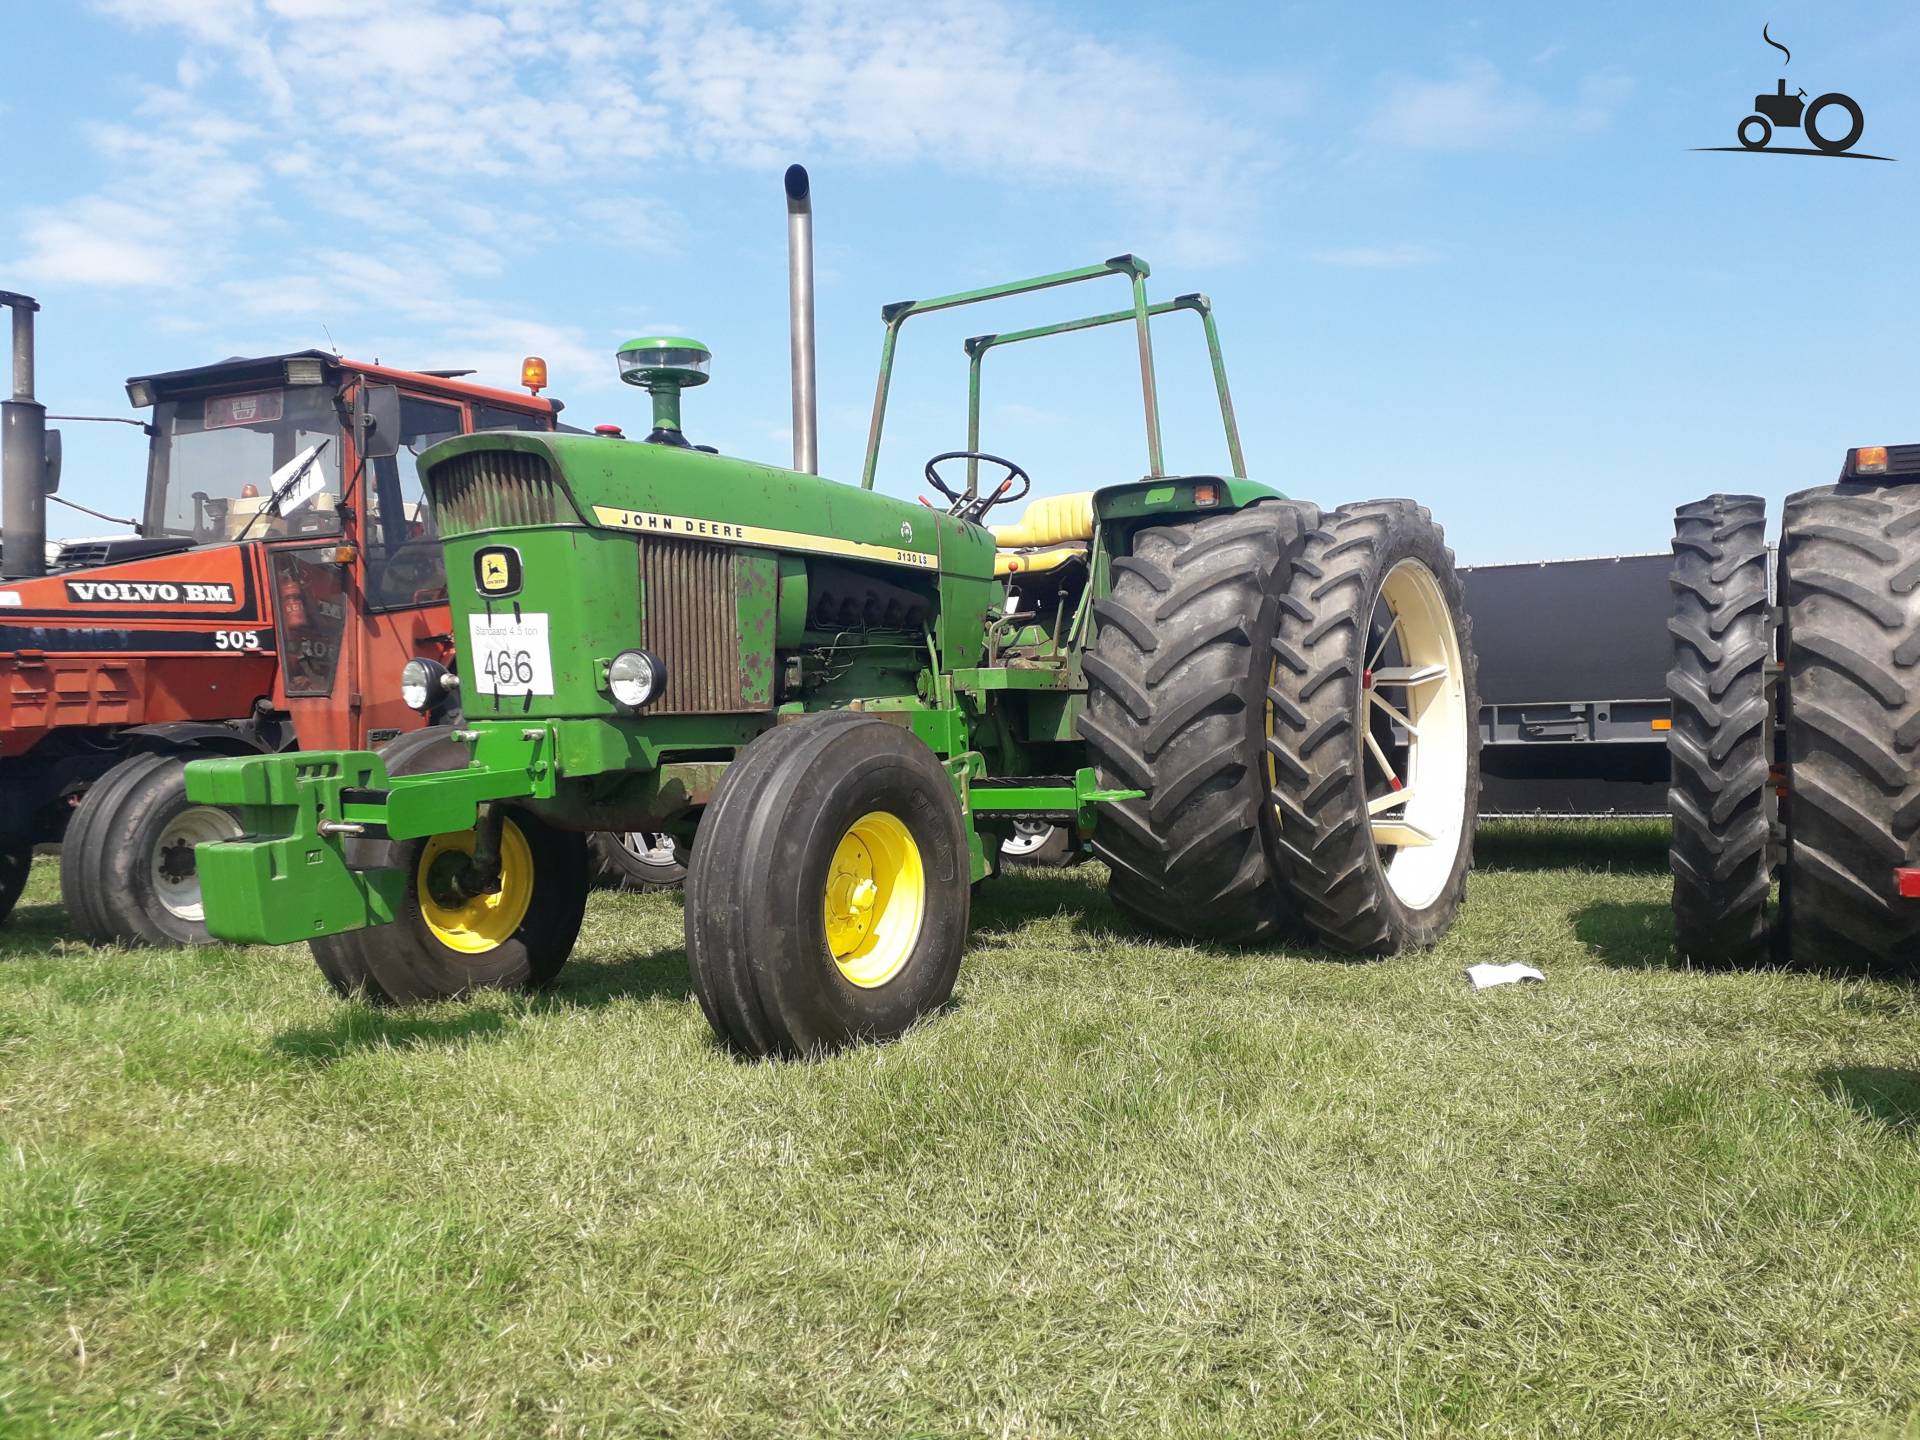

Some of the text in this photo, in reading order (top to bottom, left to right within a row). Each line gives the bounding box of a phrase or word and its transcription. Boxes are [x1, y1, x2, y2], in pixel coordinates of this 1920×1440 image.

[622, 513, 742, 538] JOHN DEERE
[897, 551, 928, 565] 3130 LS
[68, 582, 232, 602] VOLVO BM
[215, 631, 258, 649] 505
[524, 627, 538, 636] ton
[484, 650, 533, 684] 466
